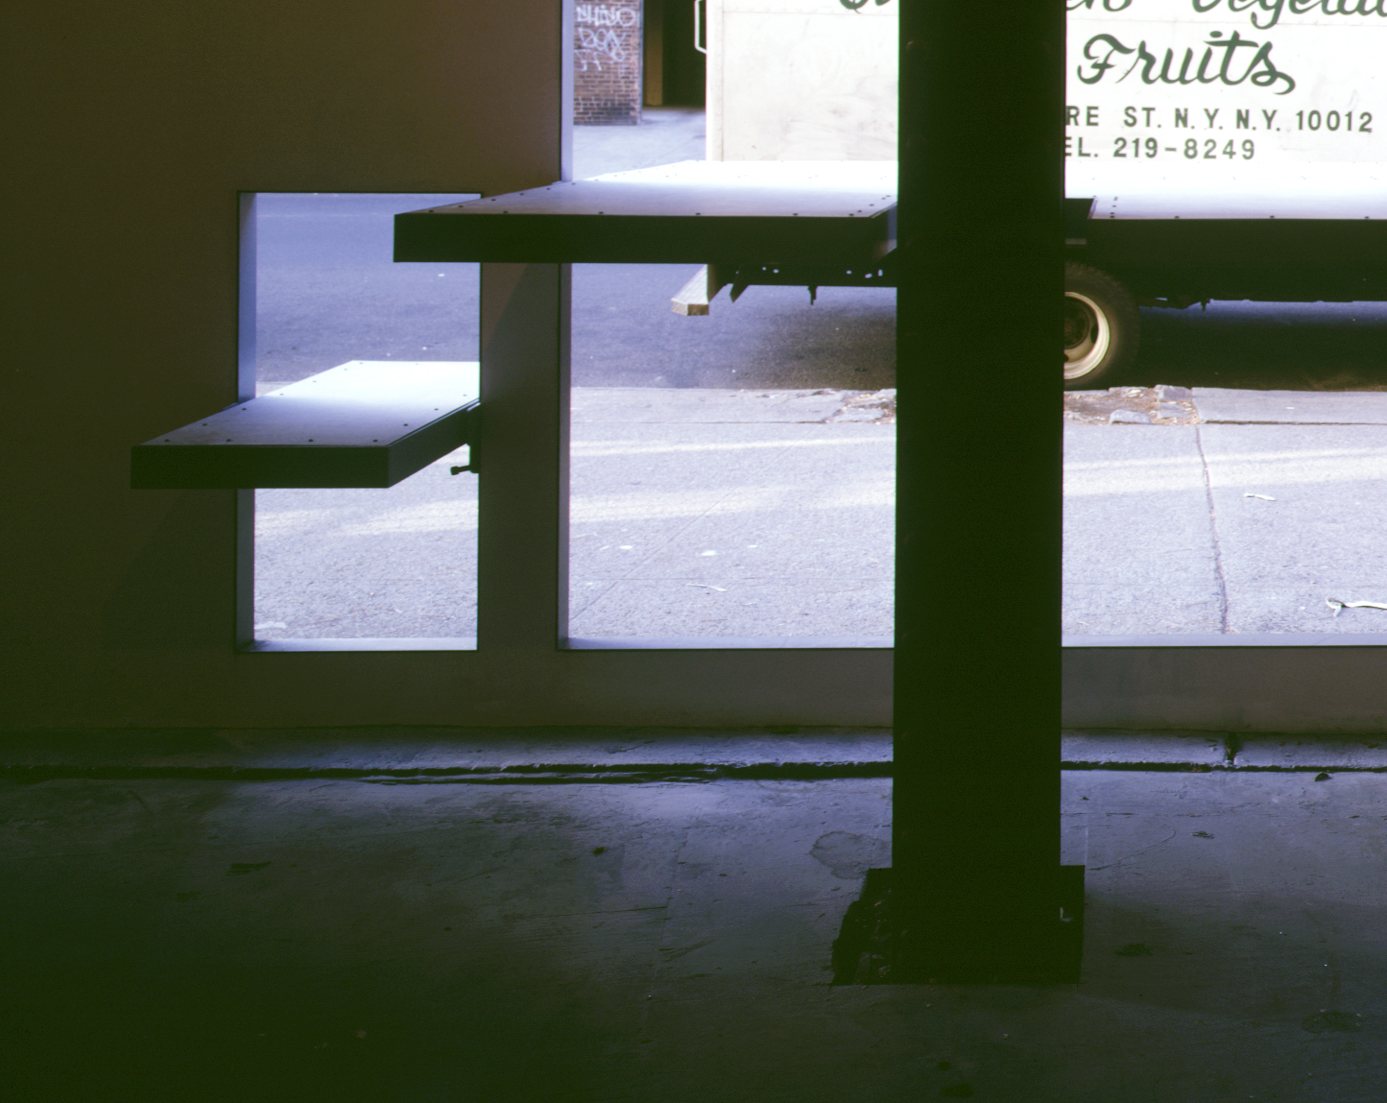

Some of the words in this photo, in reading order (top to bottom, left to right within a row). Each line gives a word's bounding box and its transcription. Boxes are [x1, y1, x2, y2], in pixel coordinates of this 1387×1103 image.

[1076, 30, 1296, 96] Fruits
[1123, 105, 1162, 128] ST.
[1295, 109, 1373, 134] 10012
[1112, 136, 1255, 161] 219-8249
